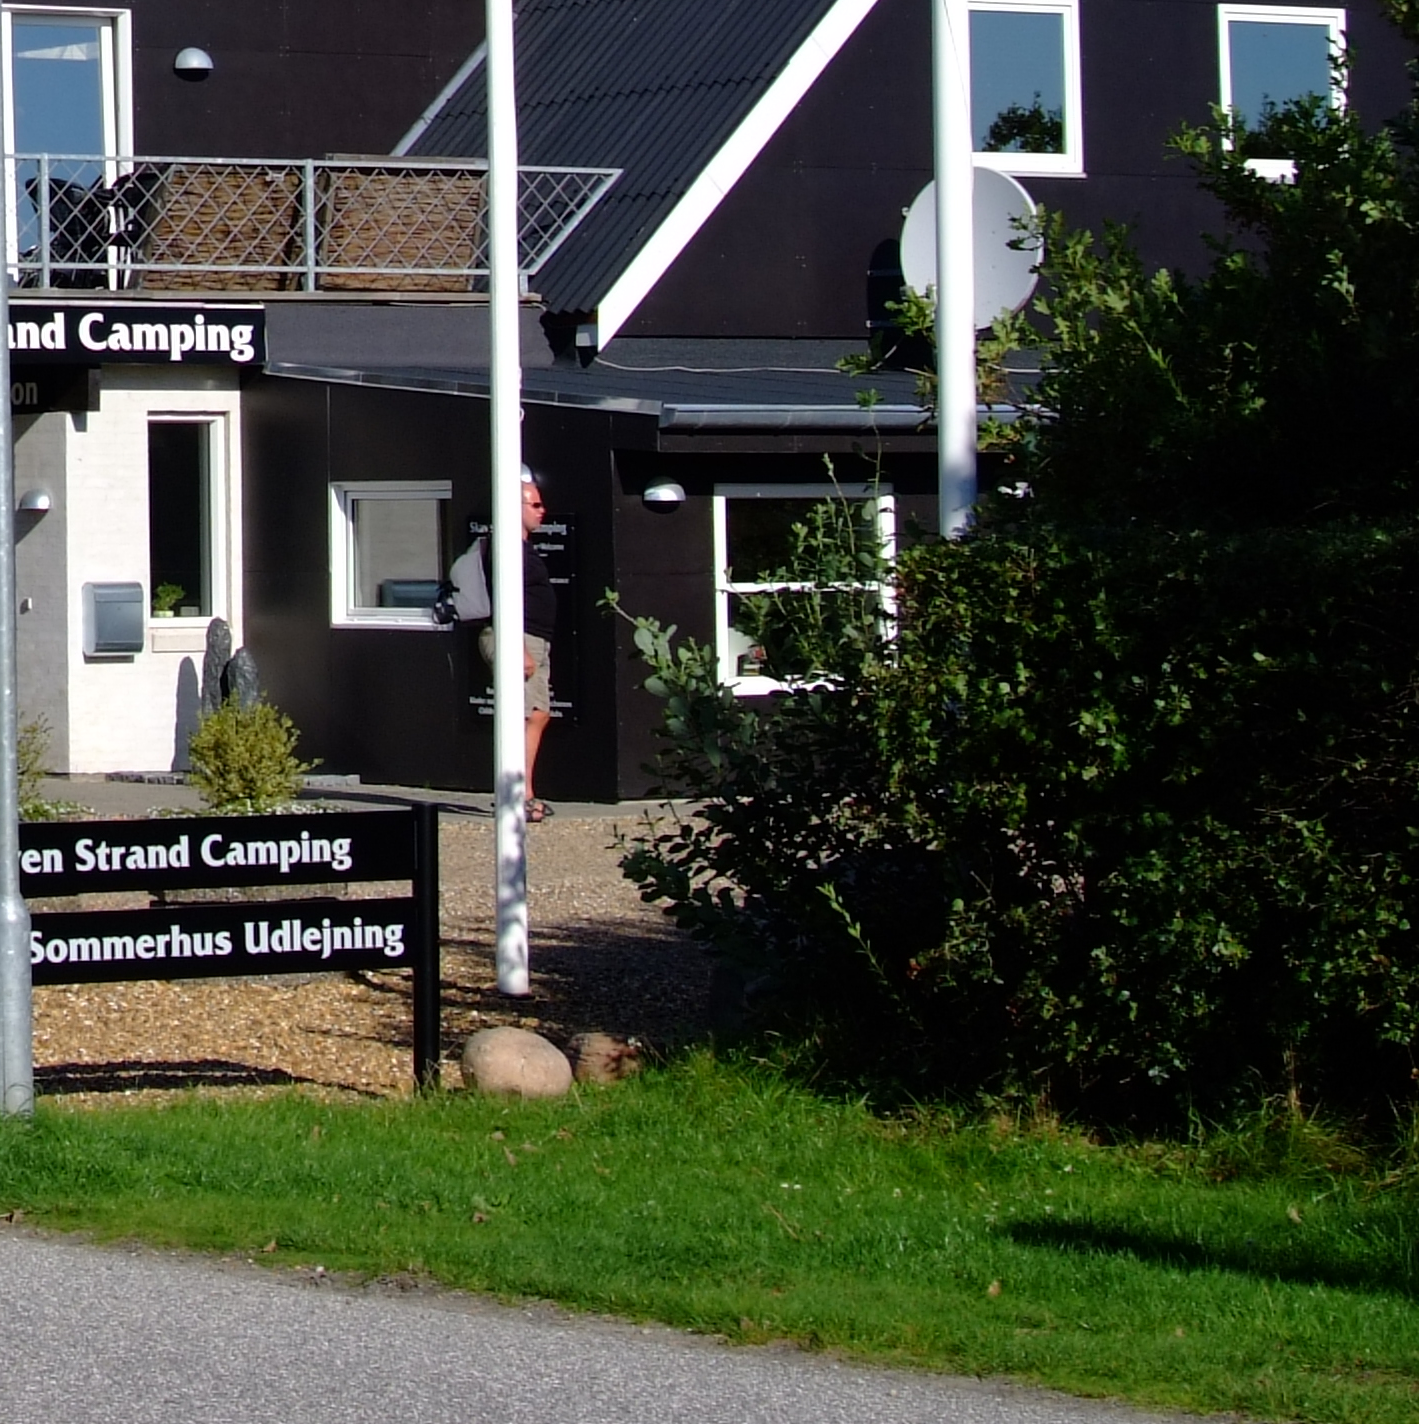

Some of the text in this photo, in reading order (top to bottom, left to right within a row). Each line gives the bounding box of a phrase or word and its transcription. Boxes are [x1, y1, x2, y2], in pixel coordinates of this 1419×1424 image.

[78, 313, 255, 363] Camping
[74, 834, 190, 872] Strand
[199, 830, 353, 872] Camping
[30, 924, 232, 964] Sommerhus
[243, 917, 405, 959] Udlejning
